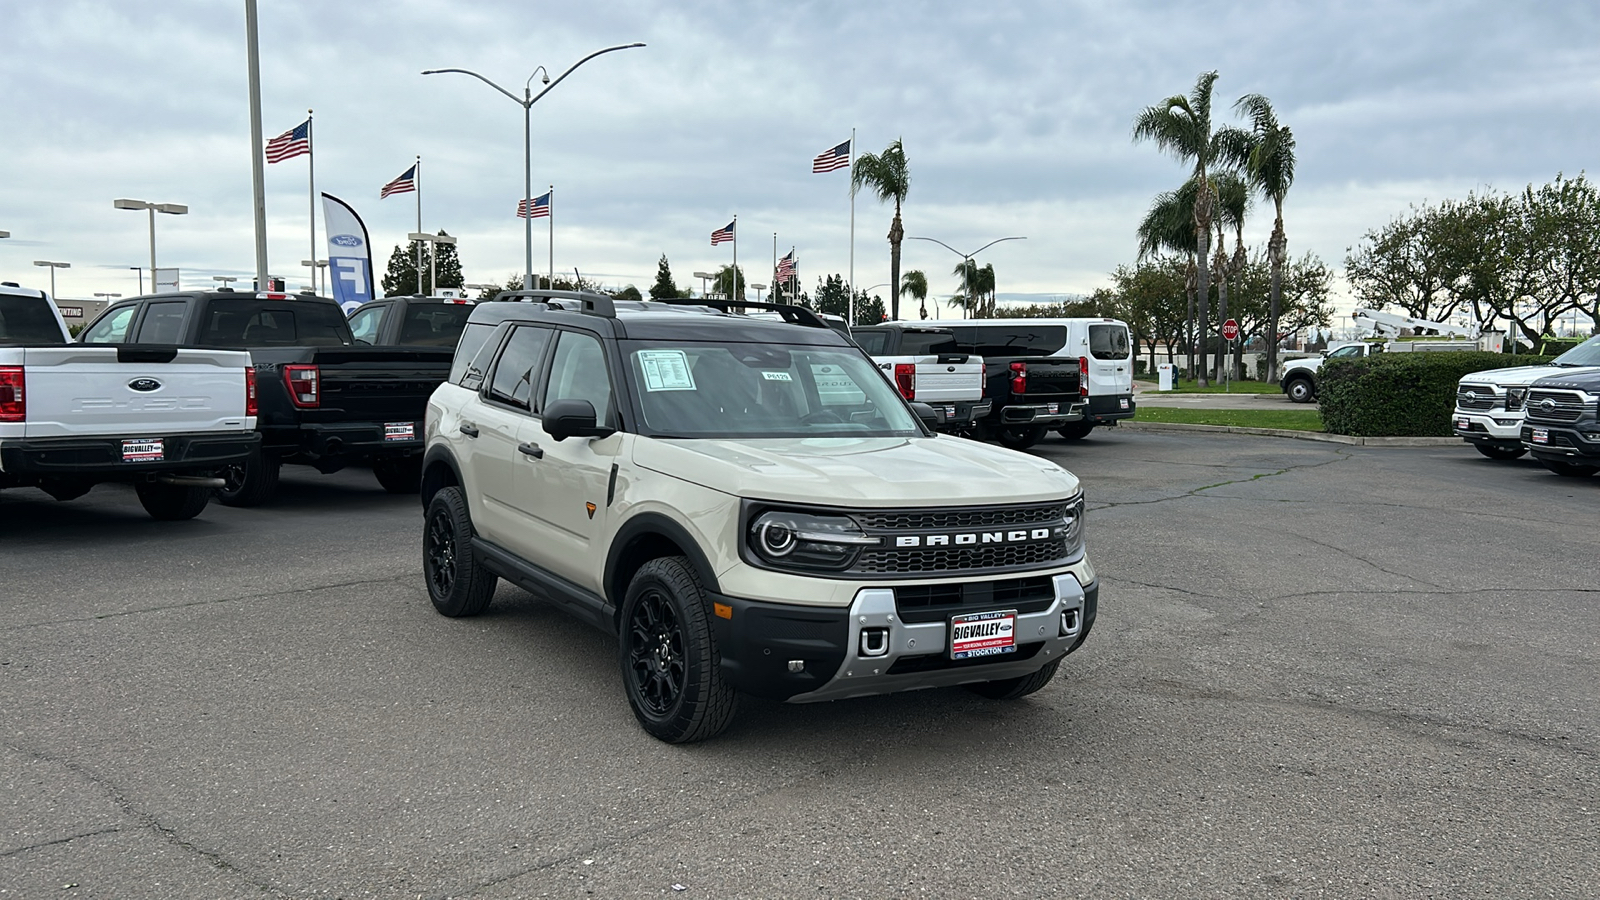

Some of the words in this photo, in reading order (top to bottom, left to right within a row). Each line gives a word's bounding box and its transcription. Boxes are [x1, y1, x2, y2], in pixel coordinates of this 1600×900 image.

[1223, 325, 1238, 334] STOP
[1025, 370, 1078, 378] CHEVROLET
[71, 397, 212, 412] F-150
[123, 445, 154, 453] BIGVALLEY
[896, 529, 1049, 547] BRONCO
[954, 622, 1001, 640] BIGVALLEY
[967, 647, 1003, 657] STOCKTON
